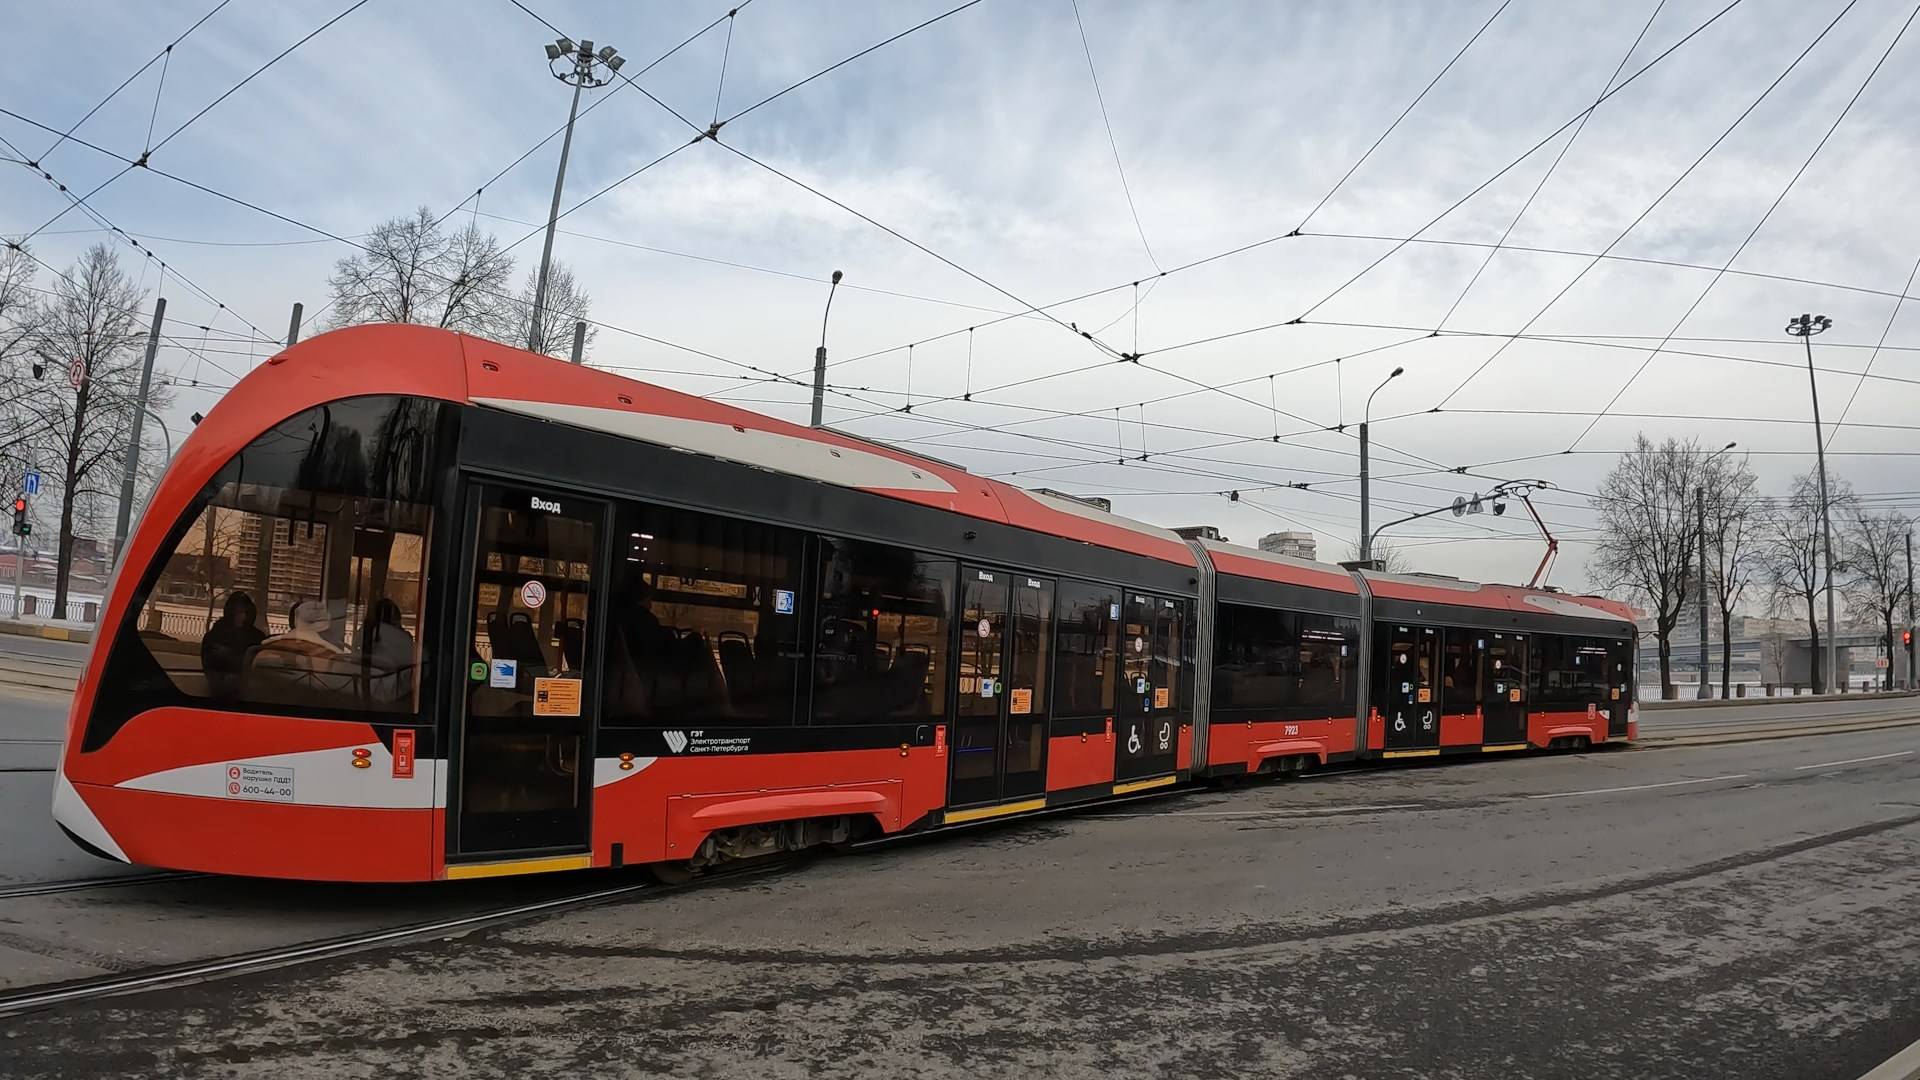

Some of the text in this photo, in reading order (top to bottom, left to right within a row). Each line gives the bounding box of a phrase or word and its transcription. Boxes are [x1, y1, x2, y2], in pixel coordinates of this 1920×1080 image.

[531, 496, 561, 514] Вход
[690, 745, 749, 753] Санкт-Петербурга
[243, 767, 273, 776] Водитель
[273, 776, 292, 784] ПДД?
[242, 785, 292, 796] 600-44-00
